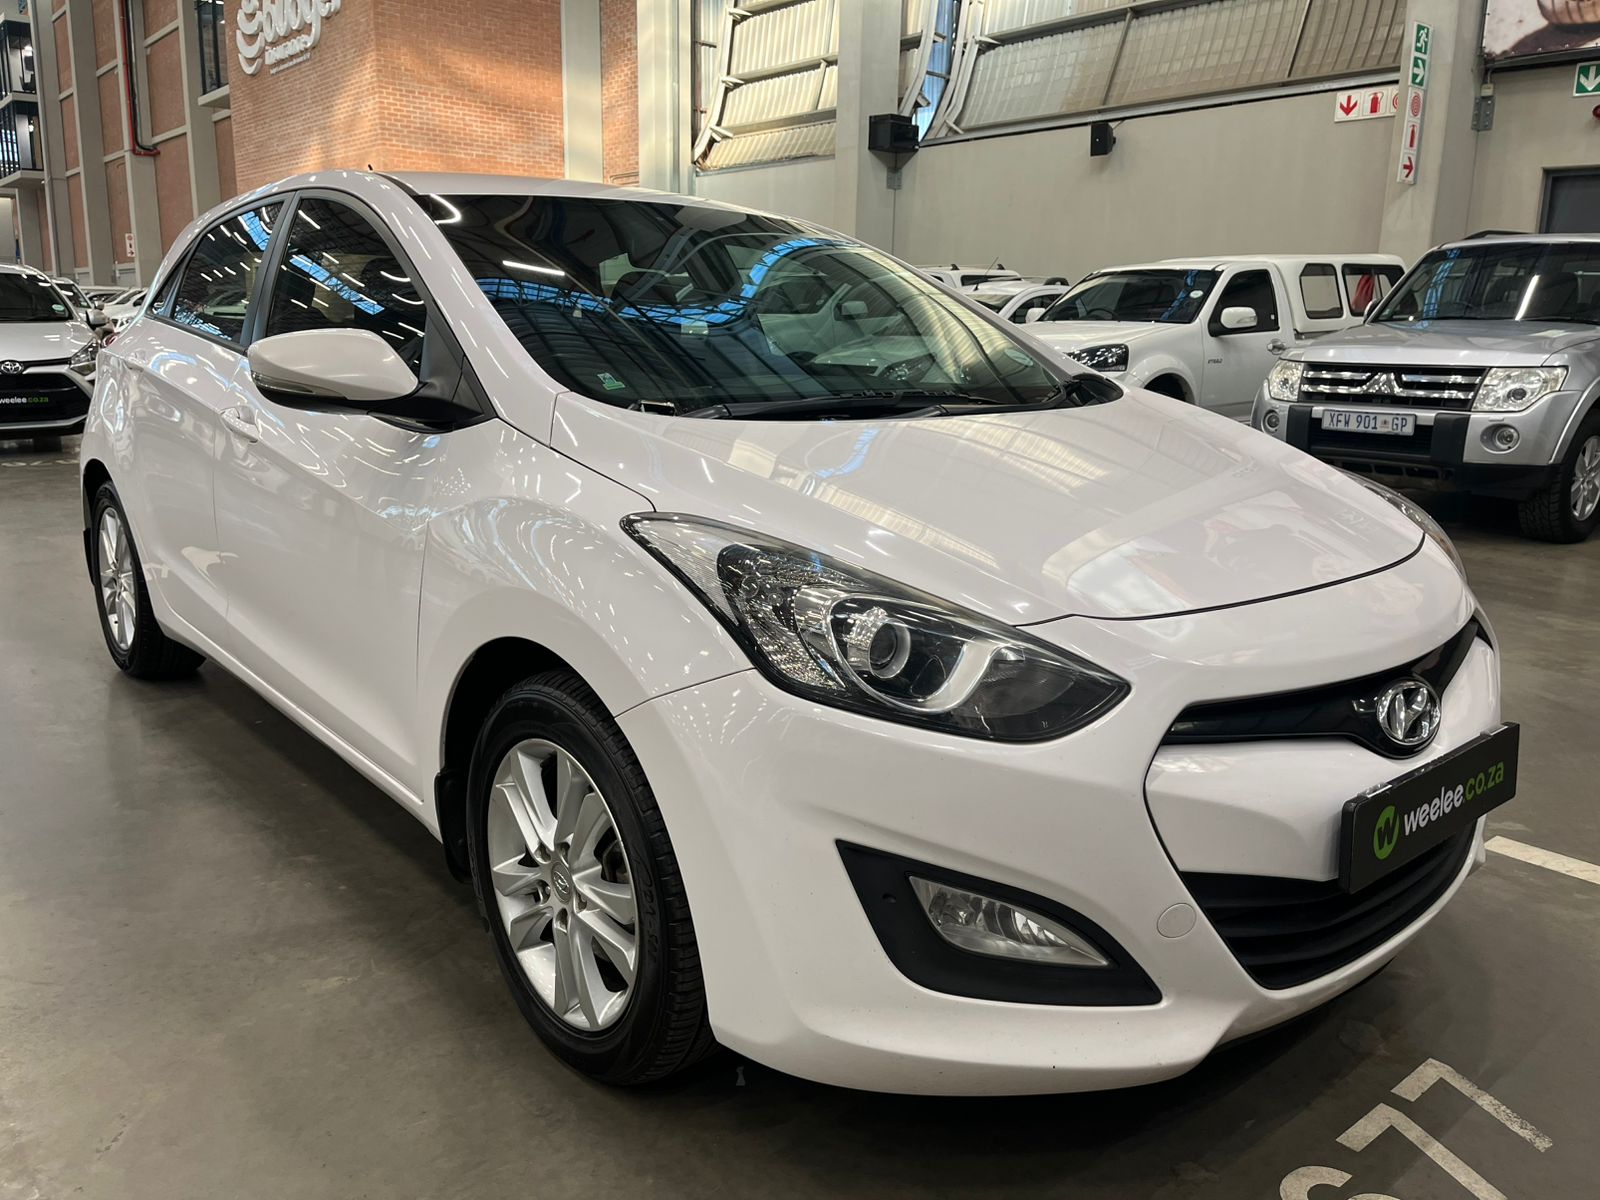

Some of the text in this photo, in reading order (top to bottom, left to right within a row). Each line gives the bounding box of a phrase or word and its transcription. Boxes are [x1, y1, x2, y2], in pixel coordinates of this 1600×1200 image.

[1328, 412, 1408, 432] XFW 901 GP
[1403, 761, 1505, 836] weelee.co.za
